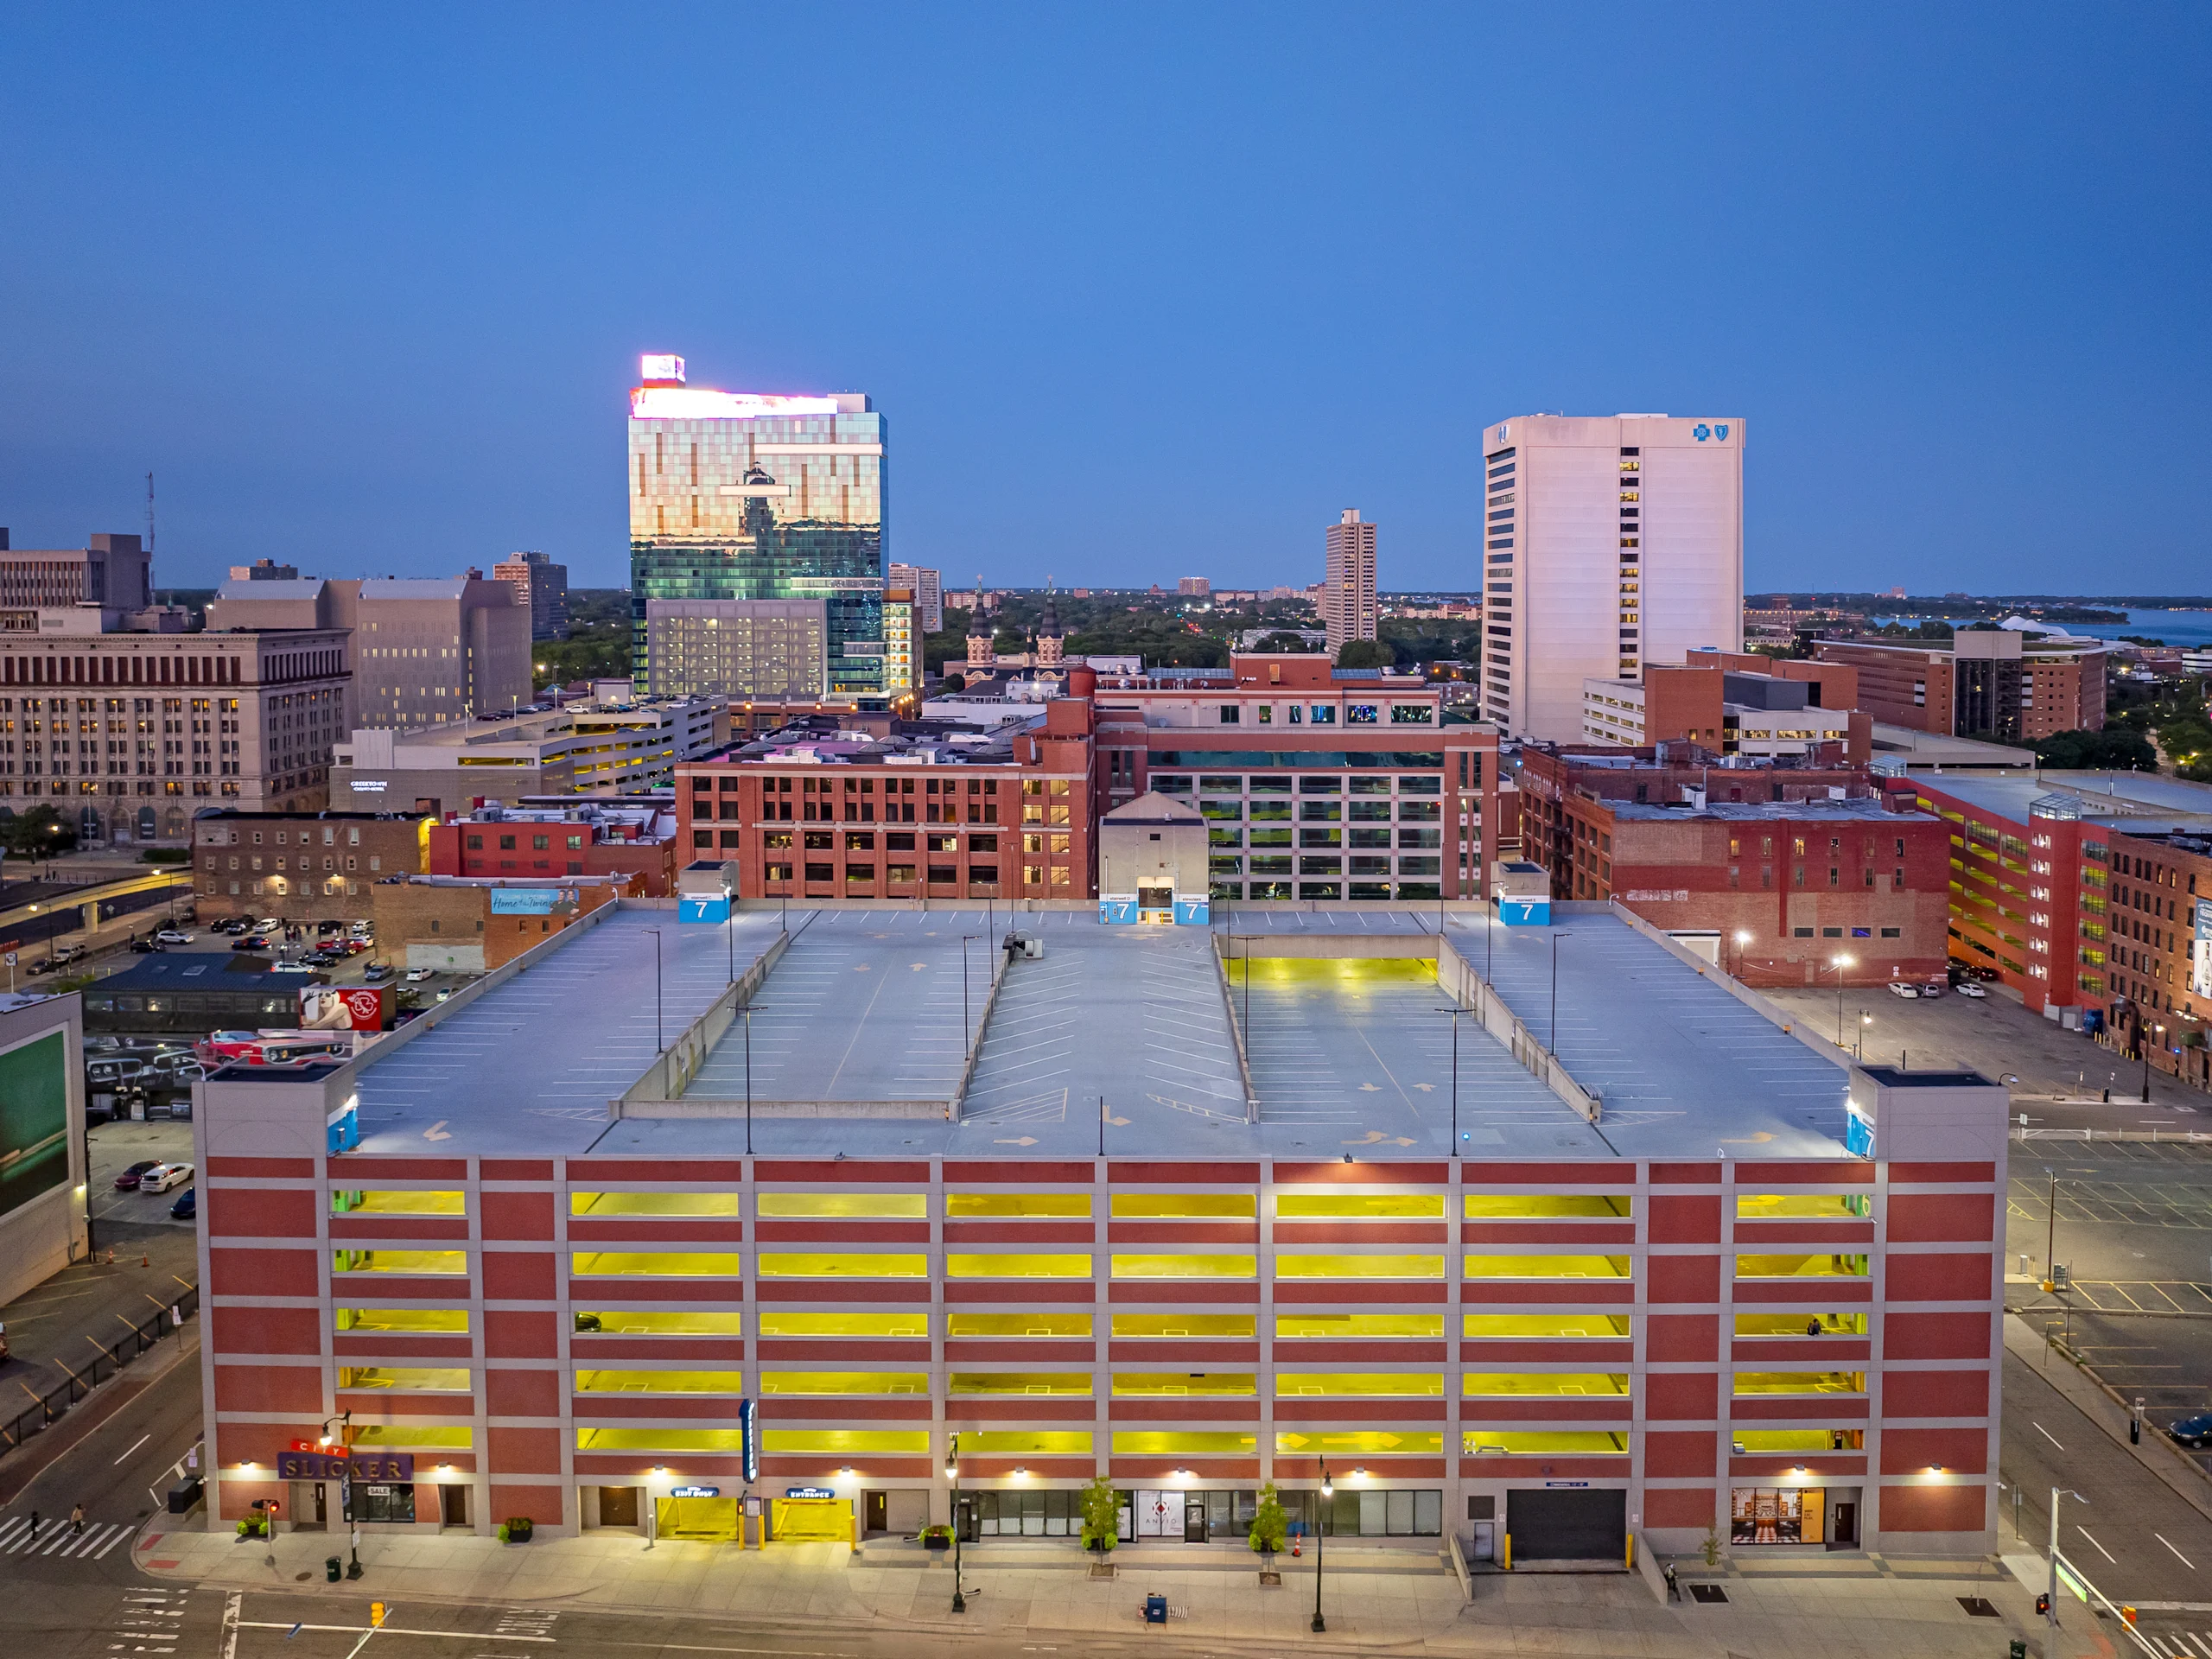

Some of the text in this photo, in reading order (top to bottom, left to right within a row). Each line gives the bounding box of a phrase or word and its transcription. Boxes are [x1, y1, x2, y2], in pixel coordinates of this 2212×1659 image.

[493, 898, 518, 909] Home
[695, 901, 708, 918] 7
[1116, 903, 1129, 919] 7
[1185, 903, 1198, 919] 7
[1521, 904, 1534, 920] 7
[1865, 1128, 1875, 1156] 7
[300, 1442, 340, 1455] CITY
[285, 1459, 403, 1478] SLICKER
